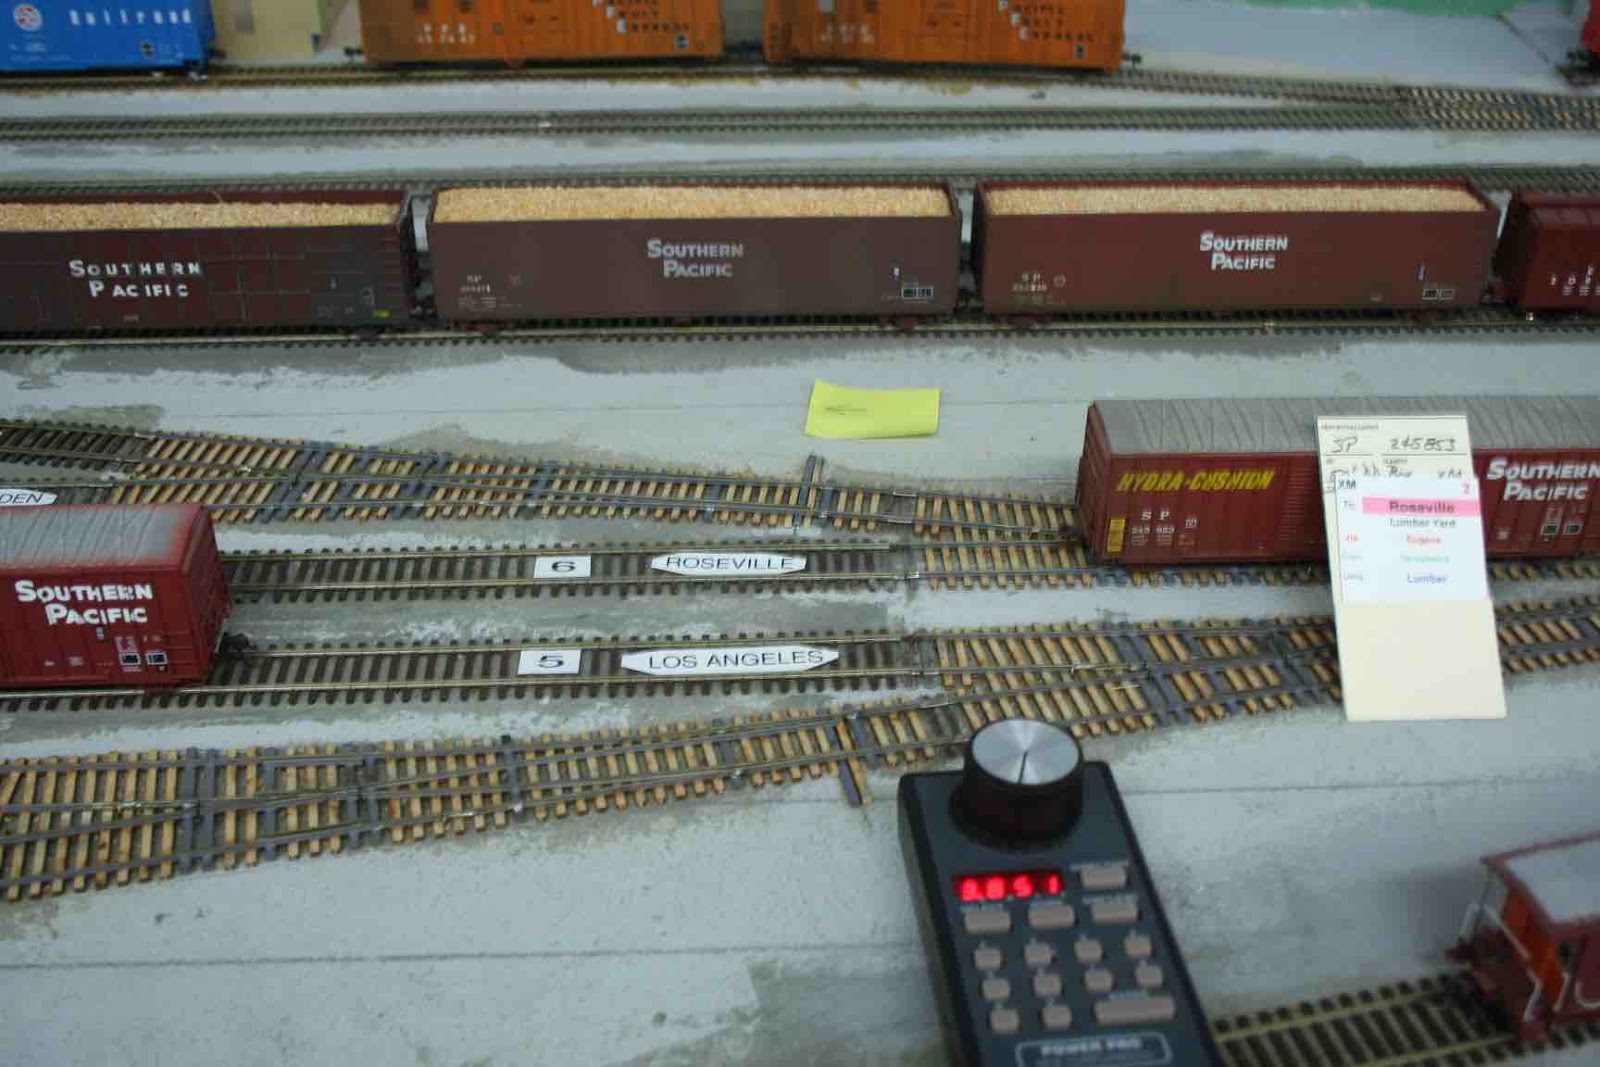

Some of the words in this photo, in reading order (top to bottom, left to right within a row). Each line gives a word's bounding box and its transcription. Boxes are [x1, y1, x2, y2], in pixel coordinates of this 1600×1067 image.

[646, 238, 744, 259] SOUTHERN
[1199, 231, 1289, 251] SOUTHERN
[68, 259, 202, 277] SOUTHERN
[663, 258, 733, 278] PACIFIC
[1211, 250, 1276, 271] PACIFIC
[88, 279, 190, 298] PACIFIC
[1486, 457, 1600, 480] SOUTHERN
[1503, 480, 1588, 501] PACIFIC
[1389, 500, 1456, 513] Roseville
[551, 560, 576, 573] 6
[665, 556, 795, 571] ROSEVILLE
[14, 579, 153, 603] SOUTHERN
[44, 603, 148, 626] PACIFIC
[536, 654, 565, 669] 5
[649, 654, 698, 670] LOS
[706, 650, 824, 668] ANGELES
